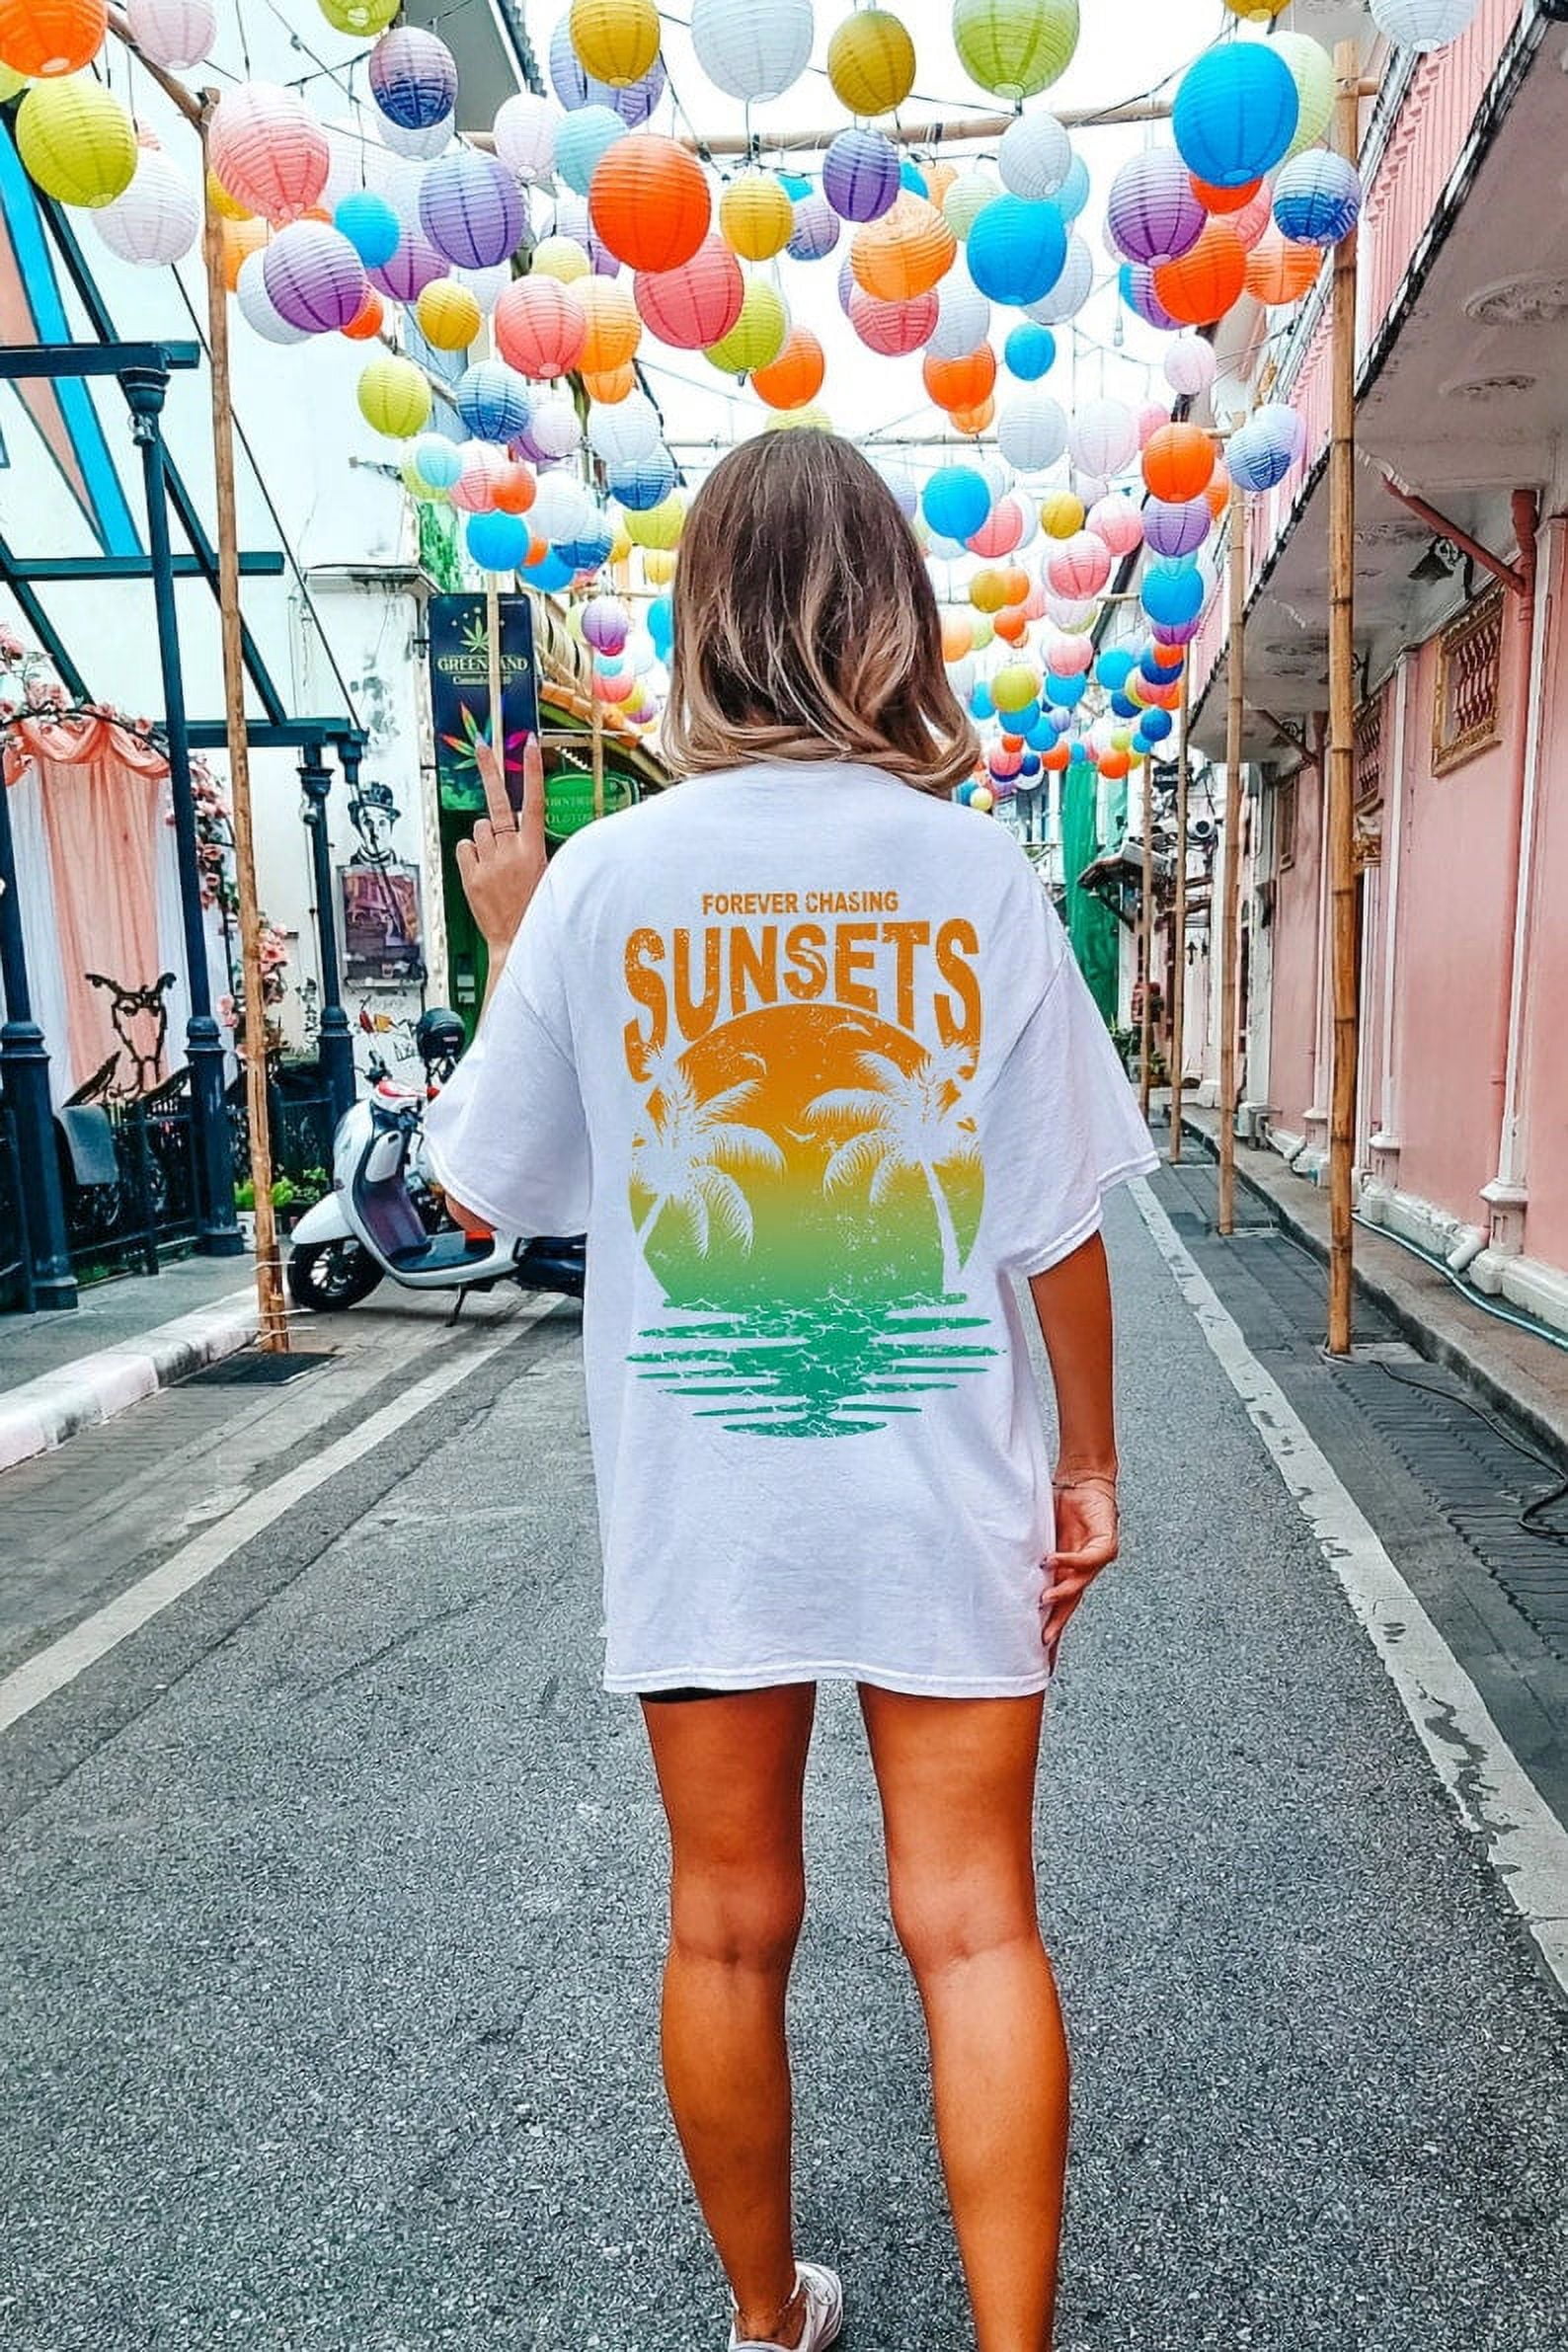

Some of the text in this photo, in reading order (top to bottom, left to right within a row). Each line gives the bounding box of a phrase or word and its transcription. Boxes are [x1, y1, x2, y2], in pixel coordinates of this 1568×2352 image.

[437, 656, 528, 671] GREENAND
[702, 891, 899, 915] FOREVER CHASING
[623, 918, 982, 1082] SUNSETS
